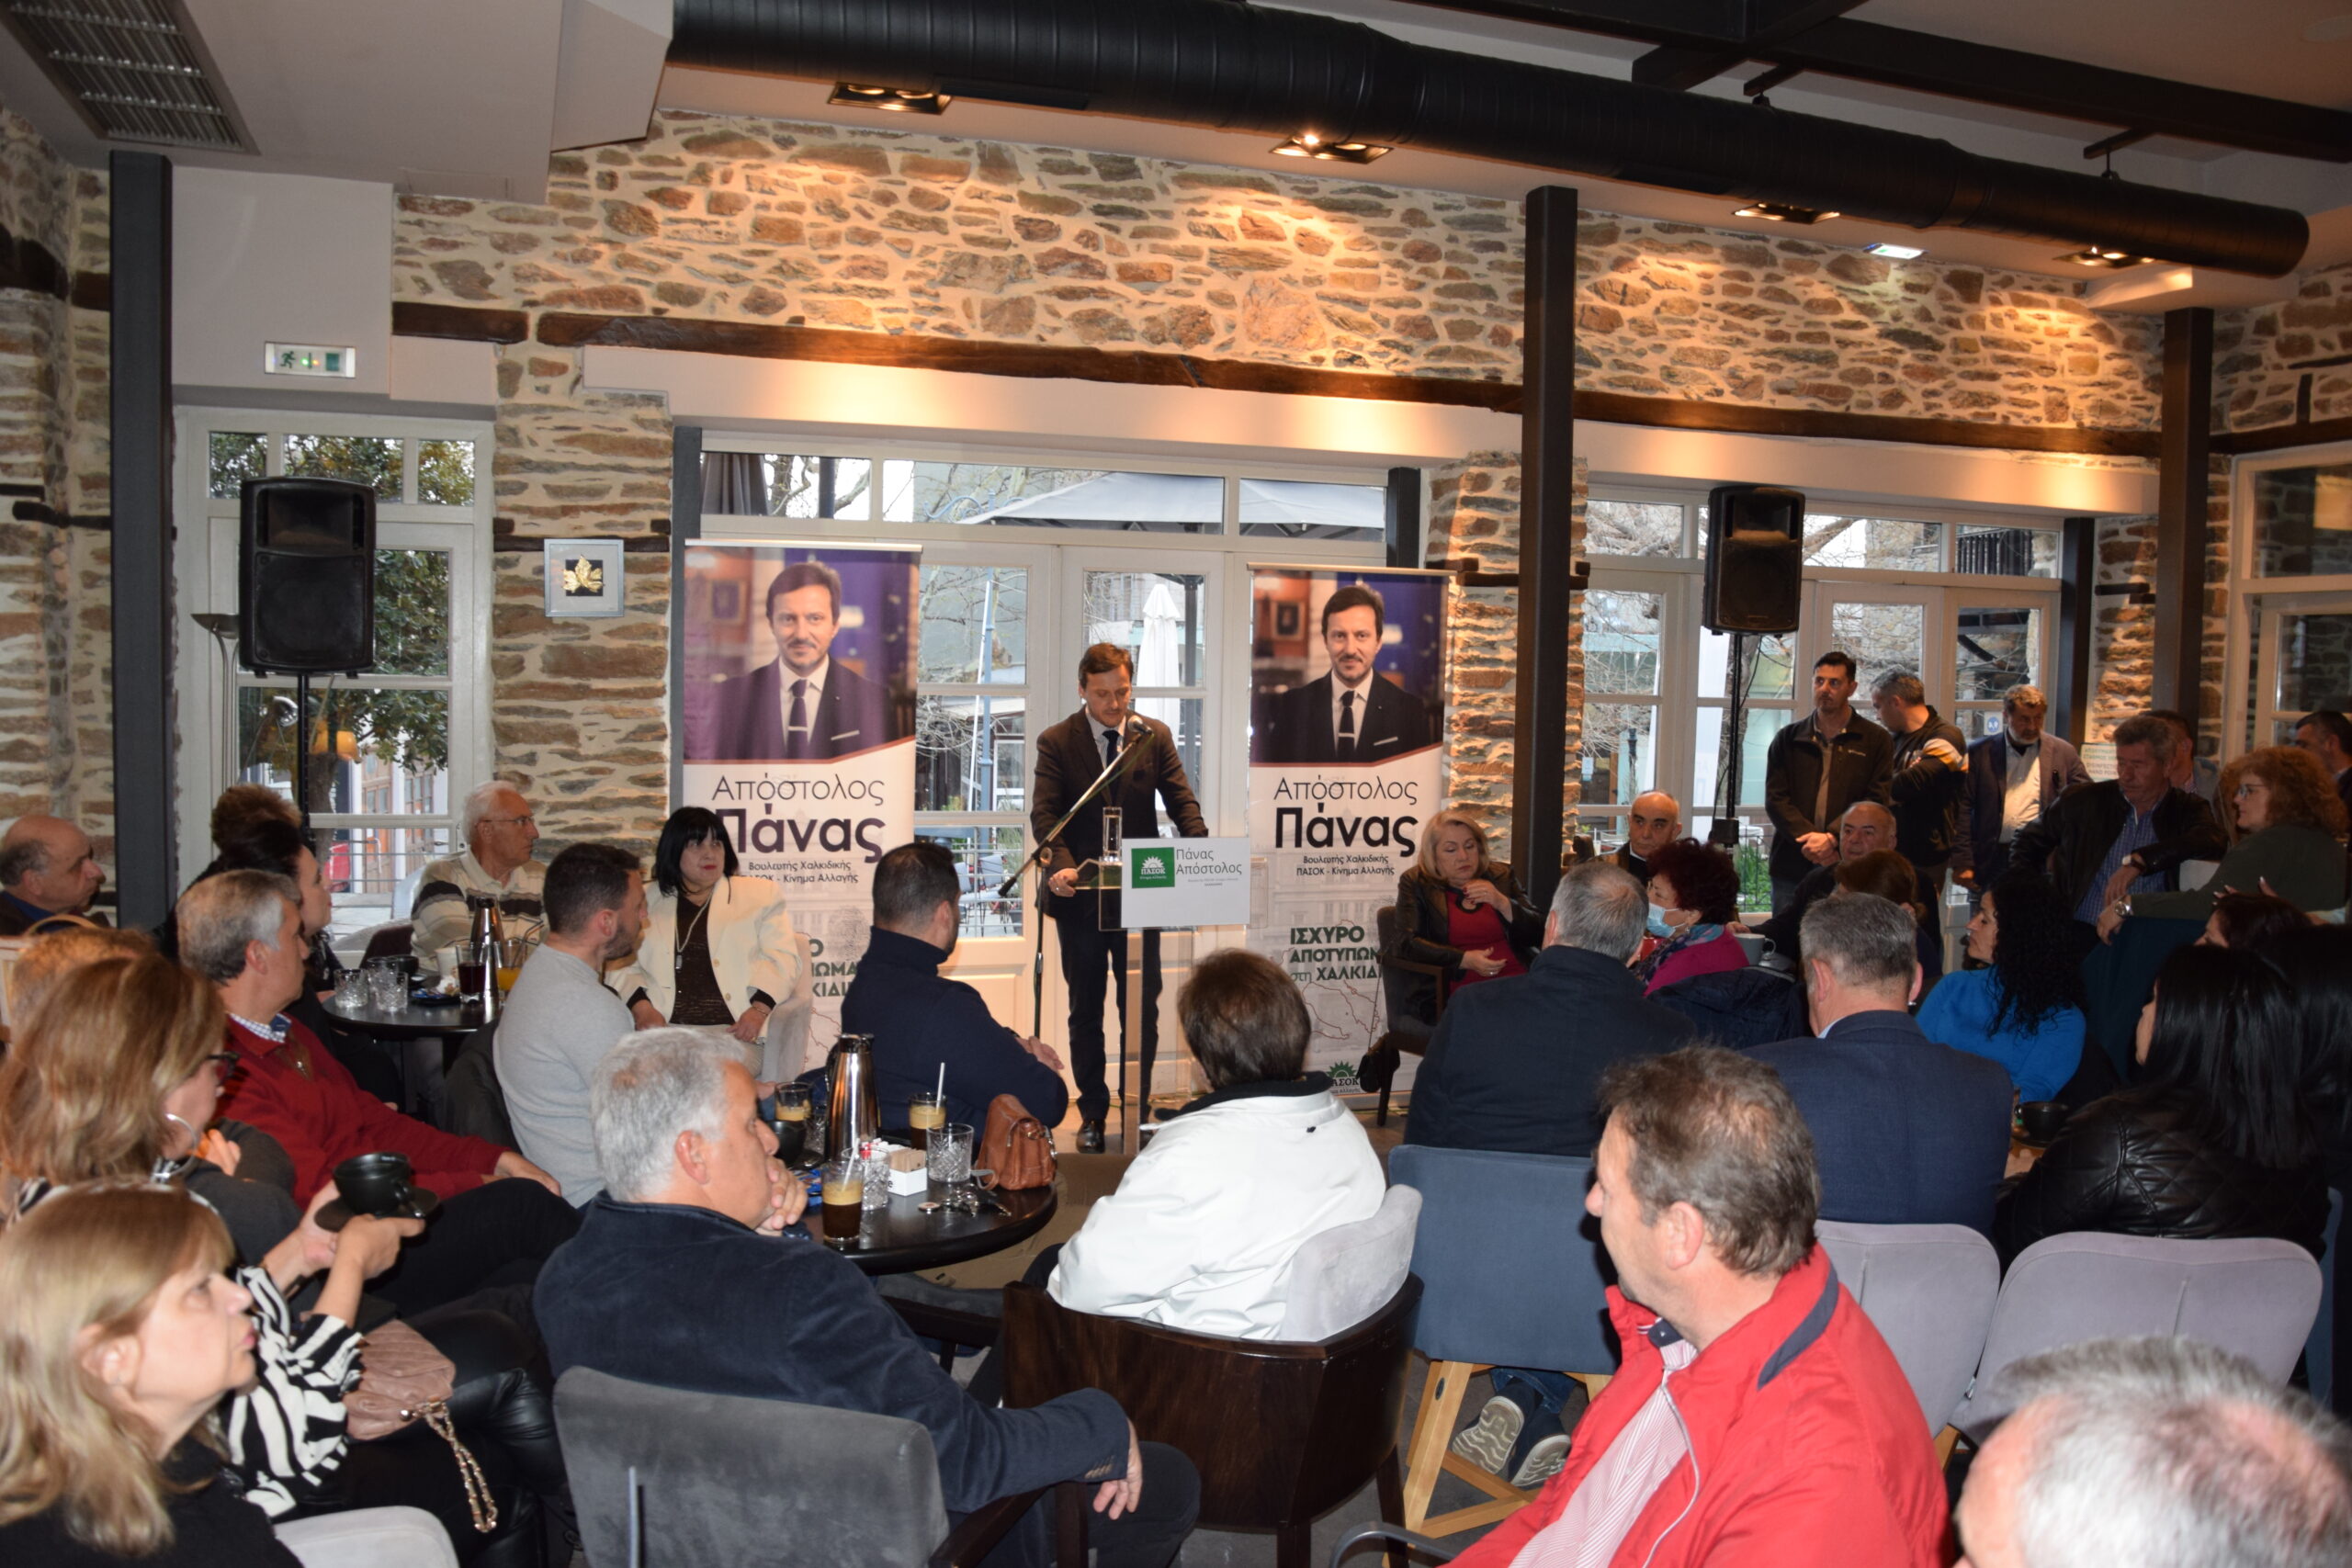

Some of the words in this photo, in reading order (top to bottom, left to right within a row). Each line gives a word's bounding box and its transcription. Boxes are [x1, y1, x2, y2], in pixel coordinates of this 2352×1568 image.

[712, 773, 886, 807] Απόστολος
[1273, 774, 1419, 806] Απόστολος
[716, 803, 887, 863] Πάνας
[1275, 802, 1419, 858] Πάνας
[1176, 847, 1215, 862] Πάνας
[1303, 854, 1344, 864] Βουλευτής
[1346, 854, 1389, 863] Χαλκιδικής
[749, 861, 797, 872] Βουλευτής
[800, 860, 852, 871] Χαλκιδικής
[1176, 862, 1242, 875] Απόστολος
[1296, 867, 1325, 876] ΠΑΣΟΚ
[1331, 866, 1359, 876] Κίνημα
[1361, 865, 1396, 875] Αλλαγής
[783, 874, 815, 885] Κίνημα
[817, 873, 859, 884] Αλλαγής
[1290, 925, 1365, 945] ΙΣΧΥΡΟ
[1316, 964, 1377, 981] ΧΑΛΚΙΔ
[1331, 1077, 1360, 1087] ΑΣΟΚ
